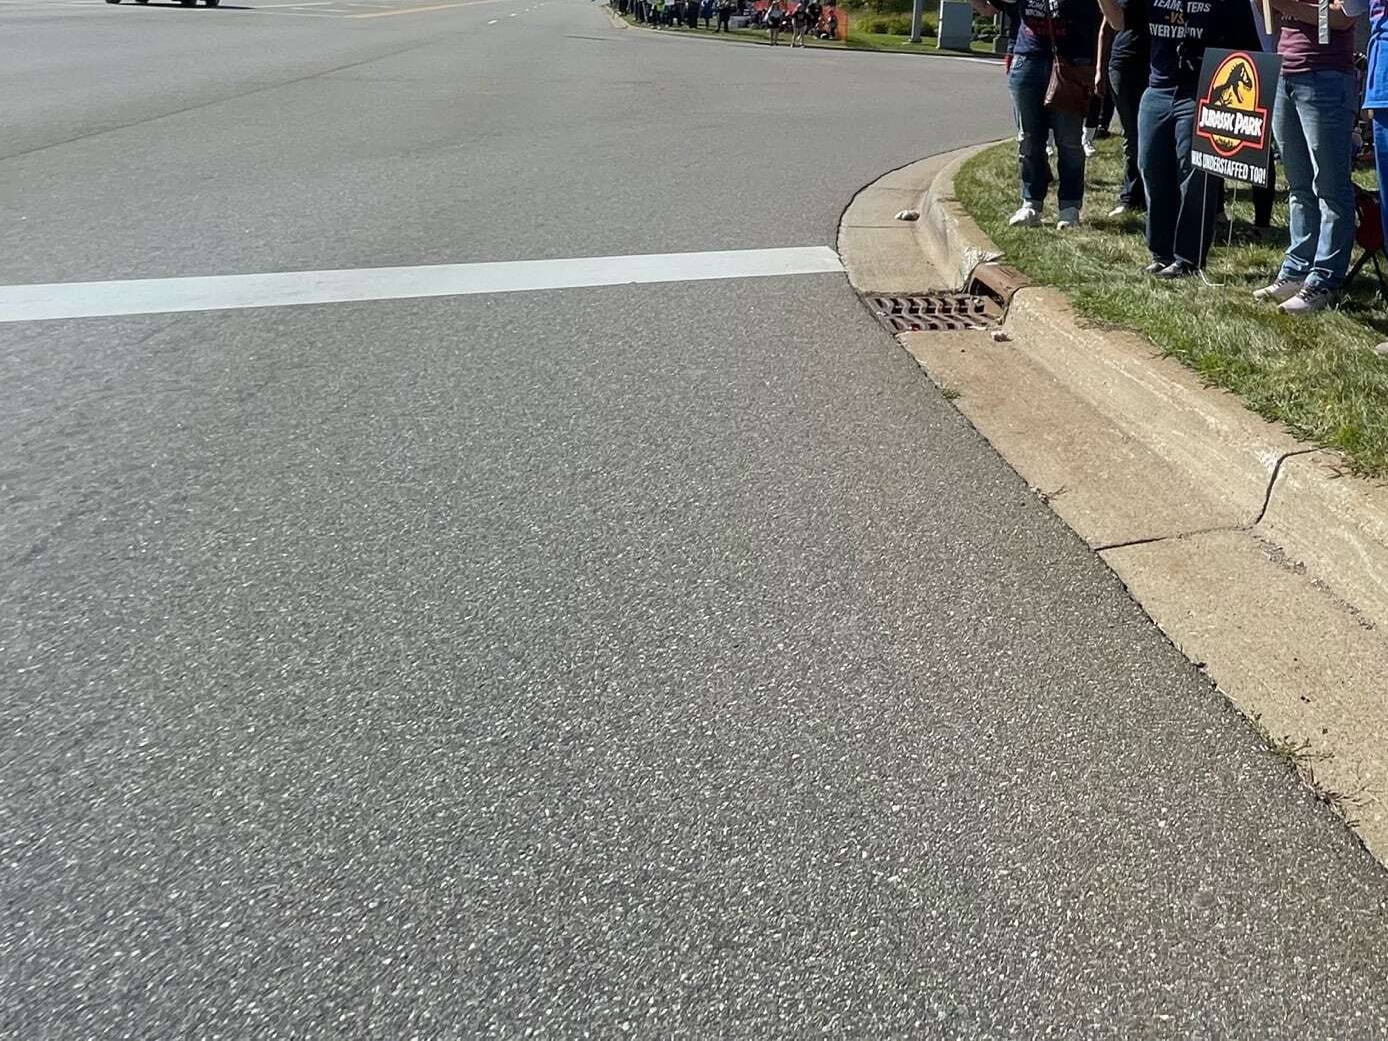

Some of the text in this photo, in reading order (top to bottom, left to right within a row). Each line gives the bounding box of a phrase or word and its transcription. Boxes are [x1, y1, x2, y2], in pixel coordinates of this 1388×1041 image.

[1234, 112, 1263, 137] PARK
[1203, 153, 1248, 179] UNDERSTAFFED
[1250, 165, 1266, 184] TOO!
